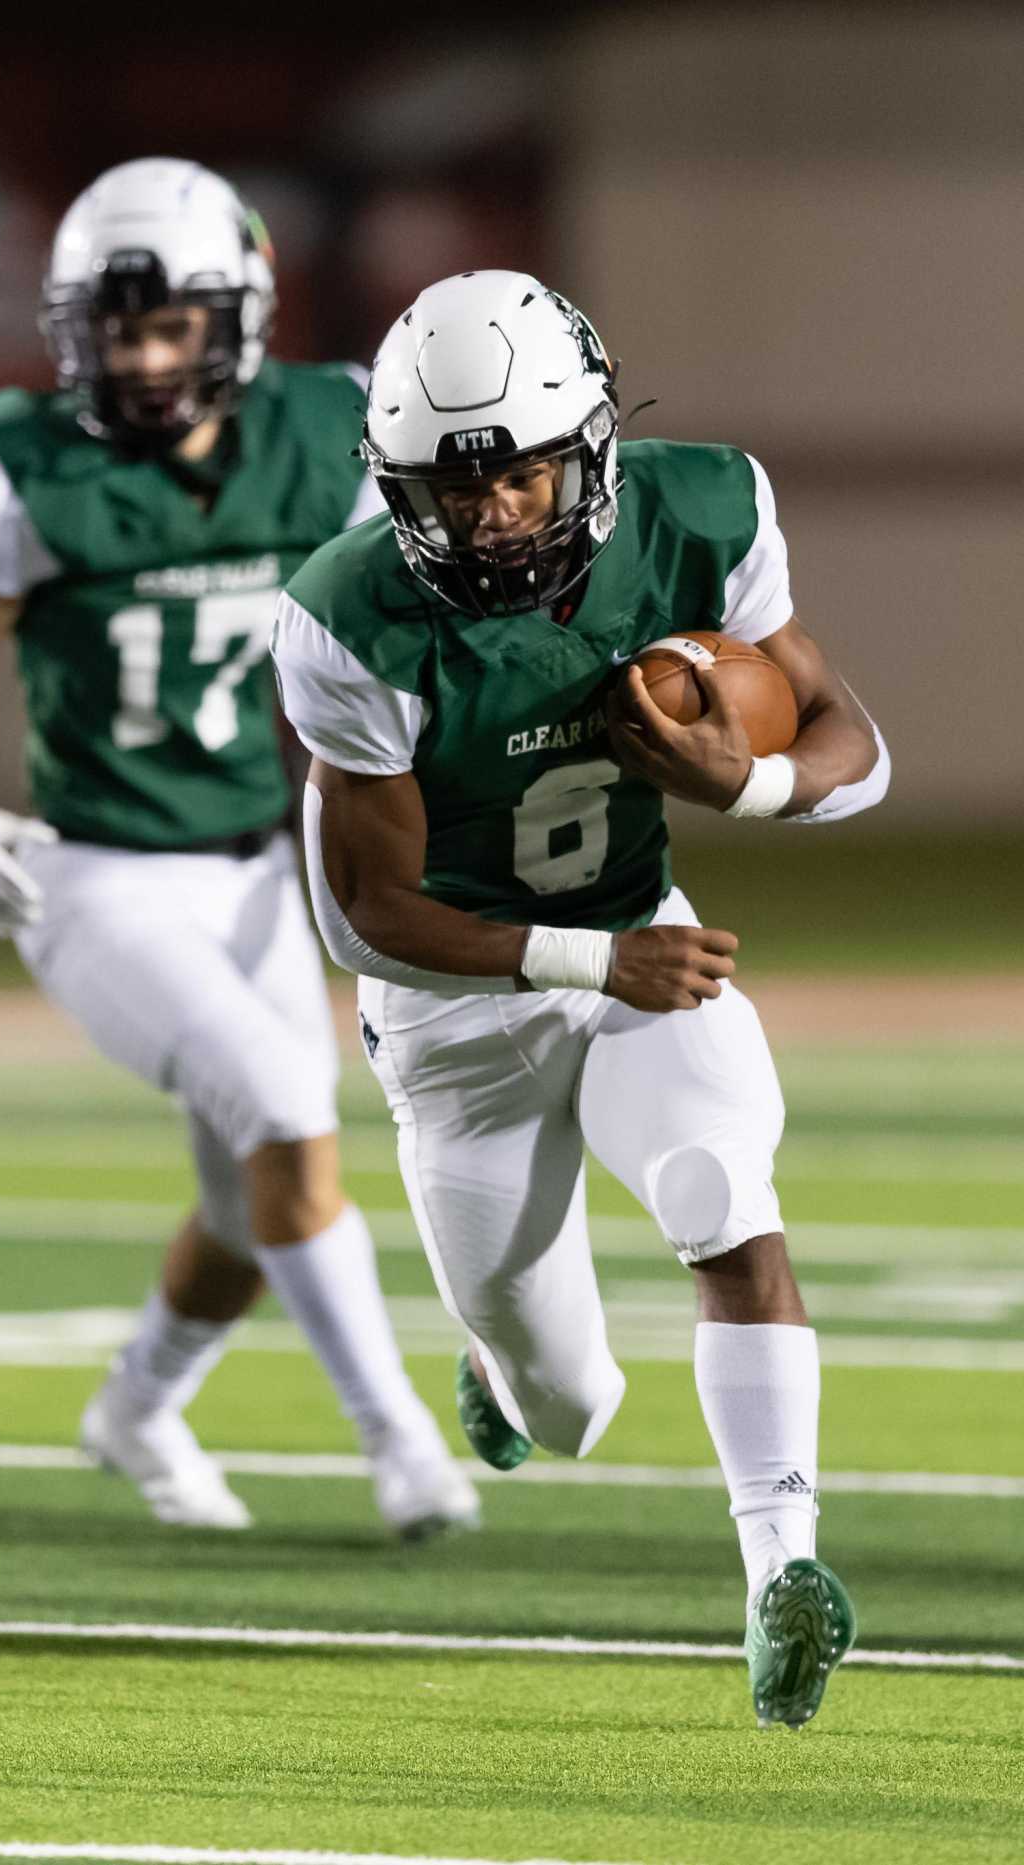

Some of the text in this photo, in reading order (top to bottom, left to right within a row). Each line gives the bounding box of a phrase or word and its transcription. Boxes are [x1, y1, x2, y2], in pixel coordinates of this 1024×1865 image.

[455, 429, 495, 452] WTM
[106, 590, 279, 752] 17
[507, 721, 581, 756] CLEAR
[512, 759, 620, 895] 6
